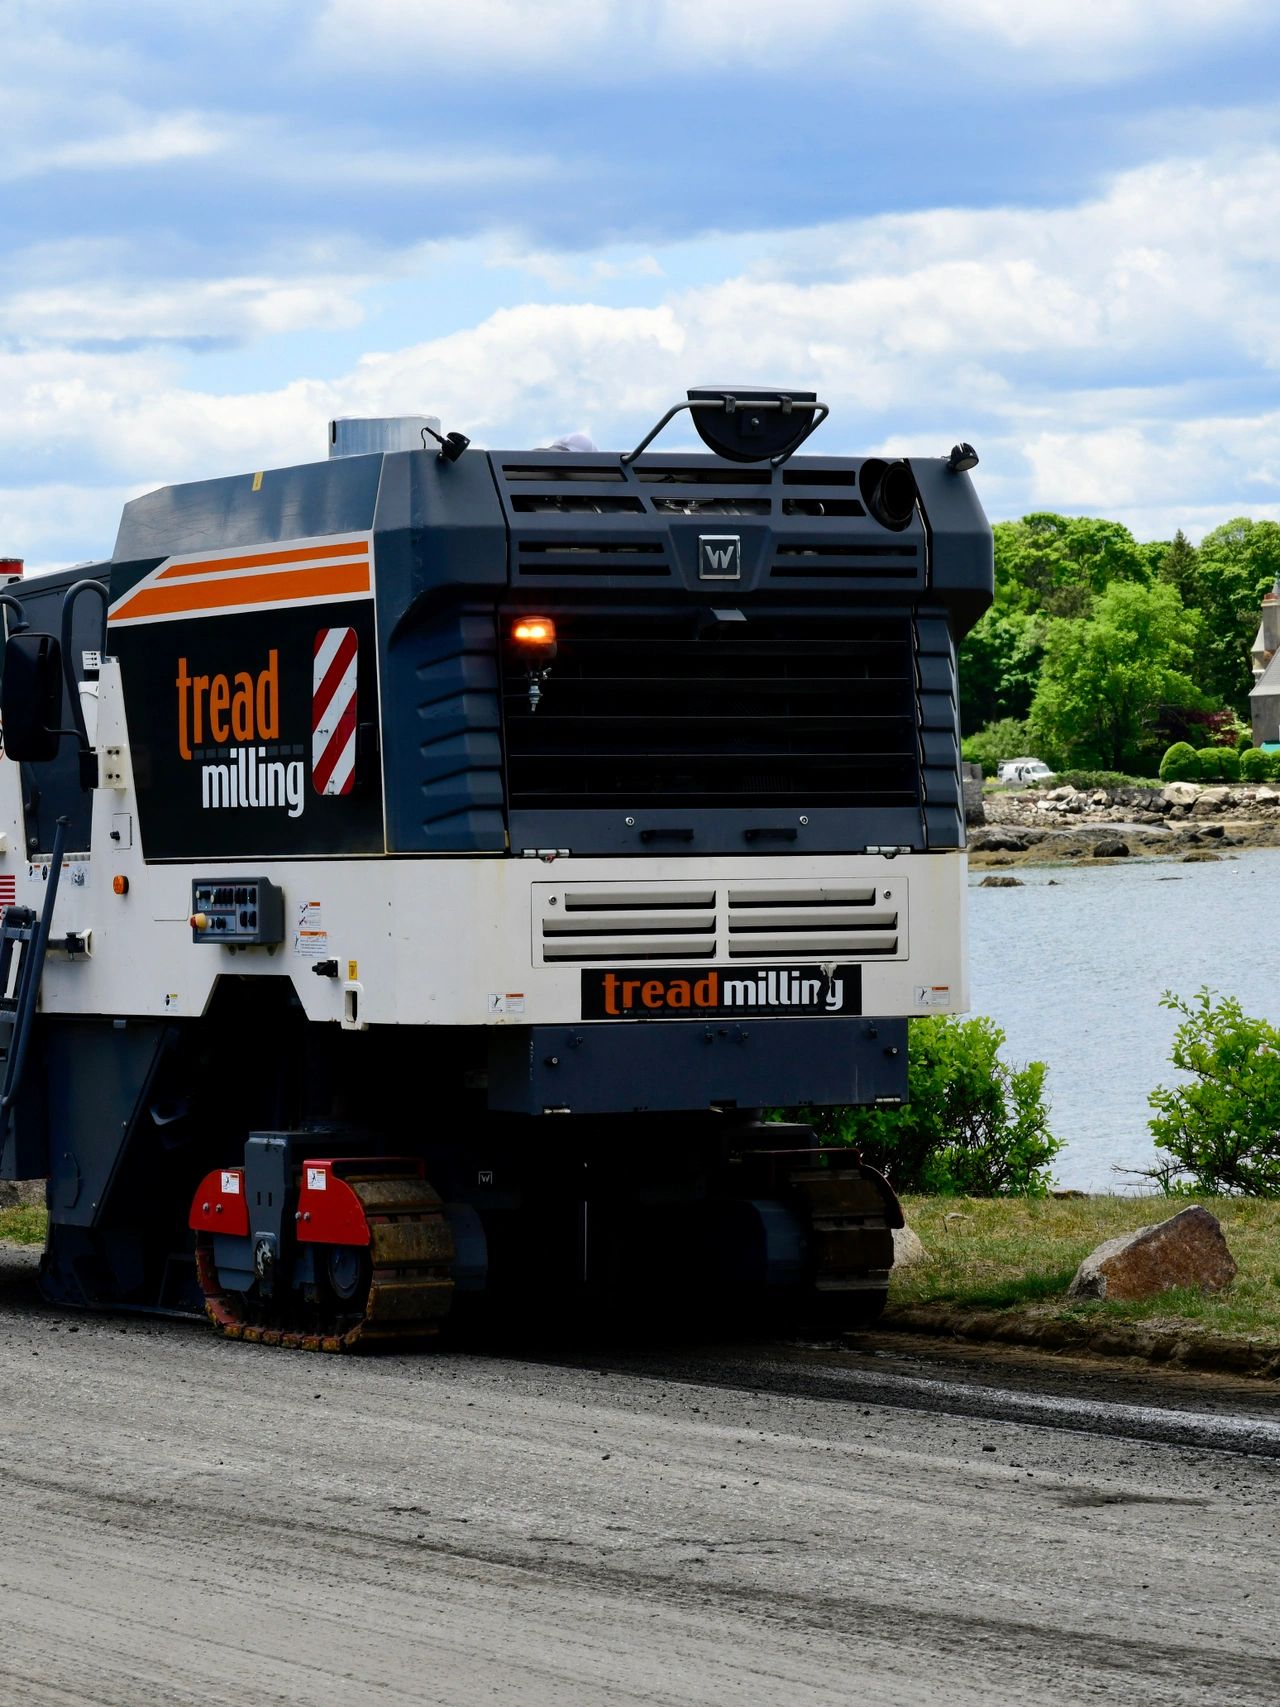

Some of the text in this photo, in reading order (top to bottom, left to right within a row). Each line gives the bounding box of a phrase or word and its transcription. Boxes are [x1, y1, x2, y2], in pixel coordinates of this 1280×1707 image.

[704, 545, 735, 569] W
[176, 649, 279, 760] tread
[202, 747, 305, 818] milling
[602, 970, 844, 1015] tread milling
